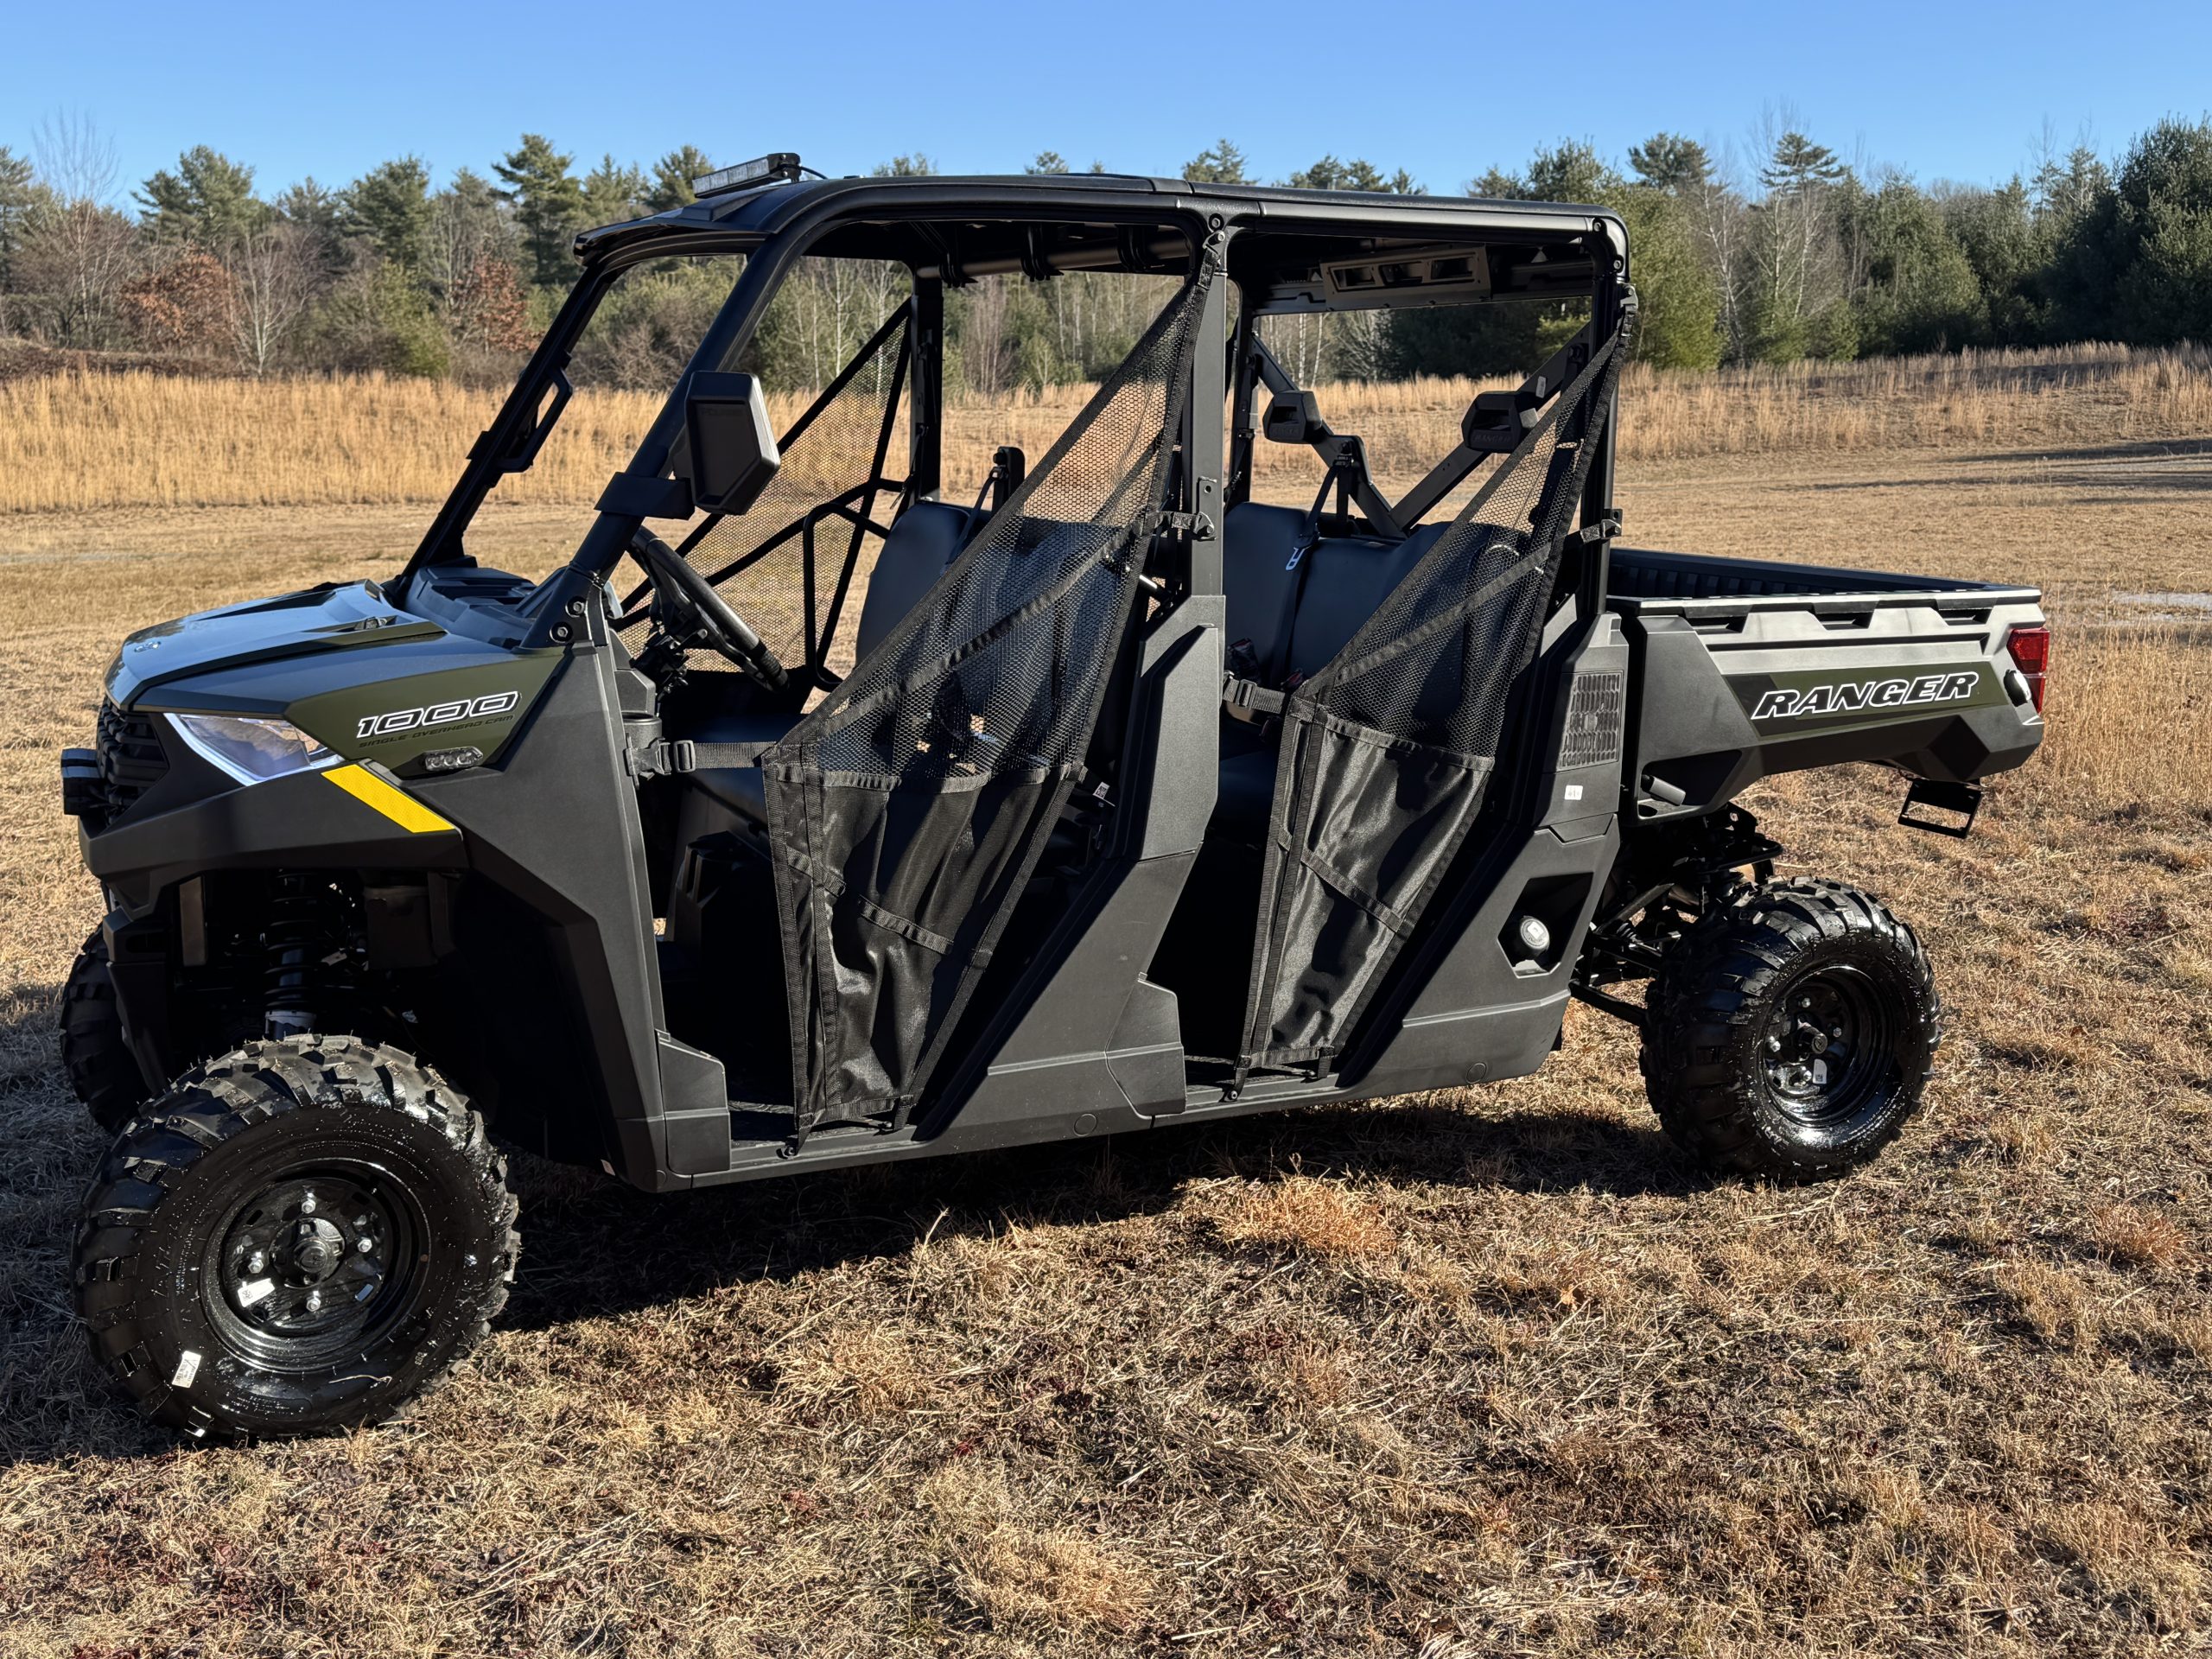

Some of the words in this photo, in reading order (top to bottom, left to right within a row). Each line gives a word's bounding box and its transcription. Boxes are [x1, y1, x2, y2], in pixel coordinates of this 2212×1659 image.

[356, 690, 521, 739] 1000
[1751, 671, 1979, 720] RANGER
[359, 734, 407, 748] SINGLE
[412, 720, 483, 739] OVERHEAD
[485, 715, 514, 725] CAM
